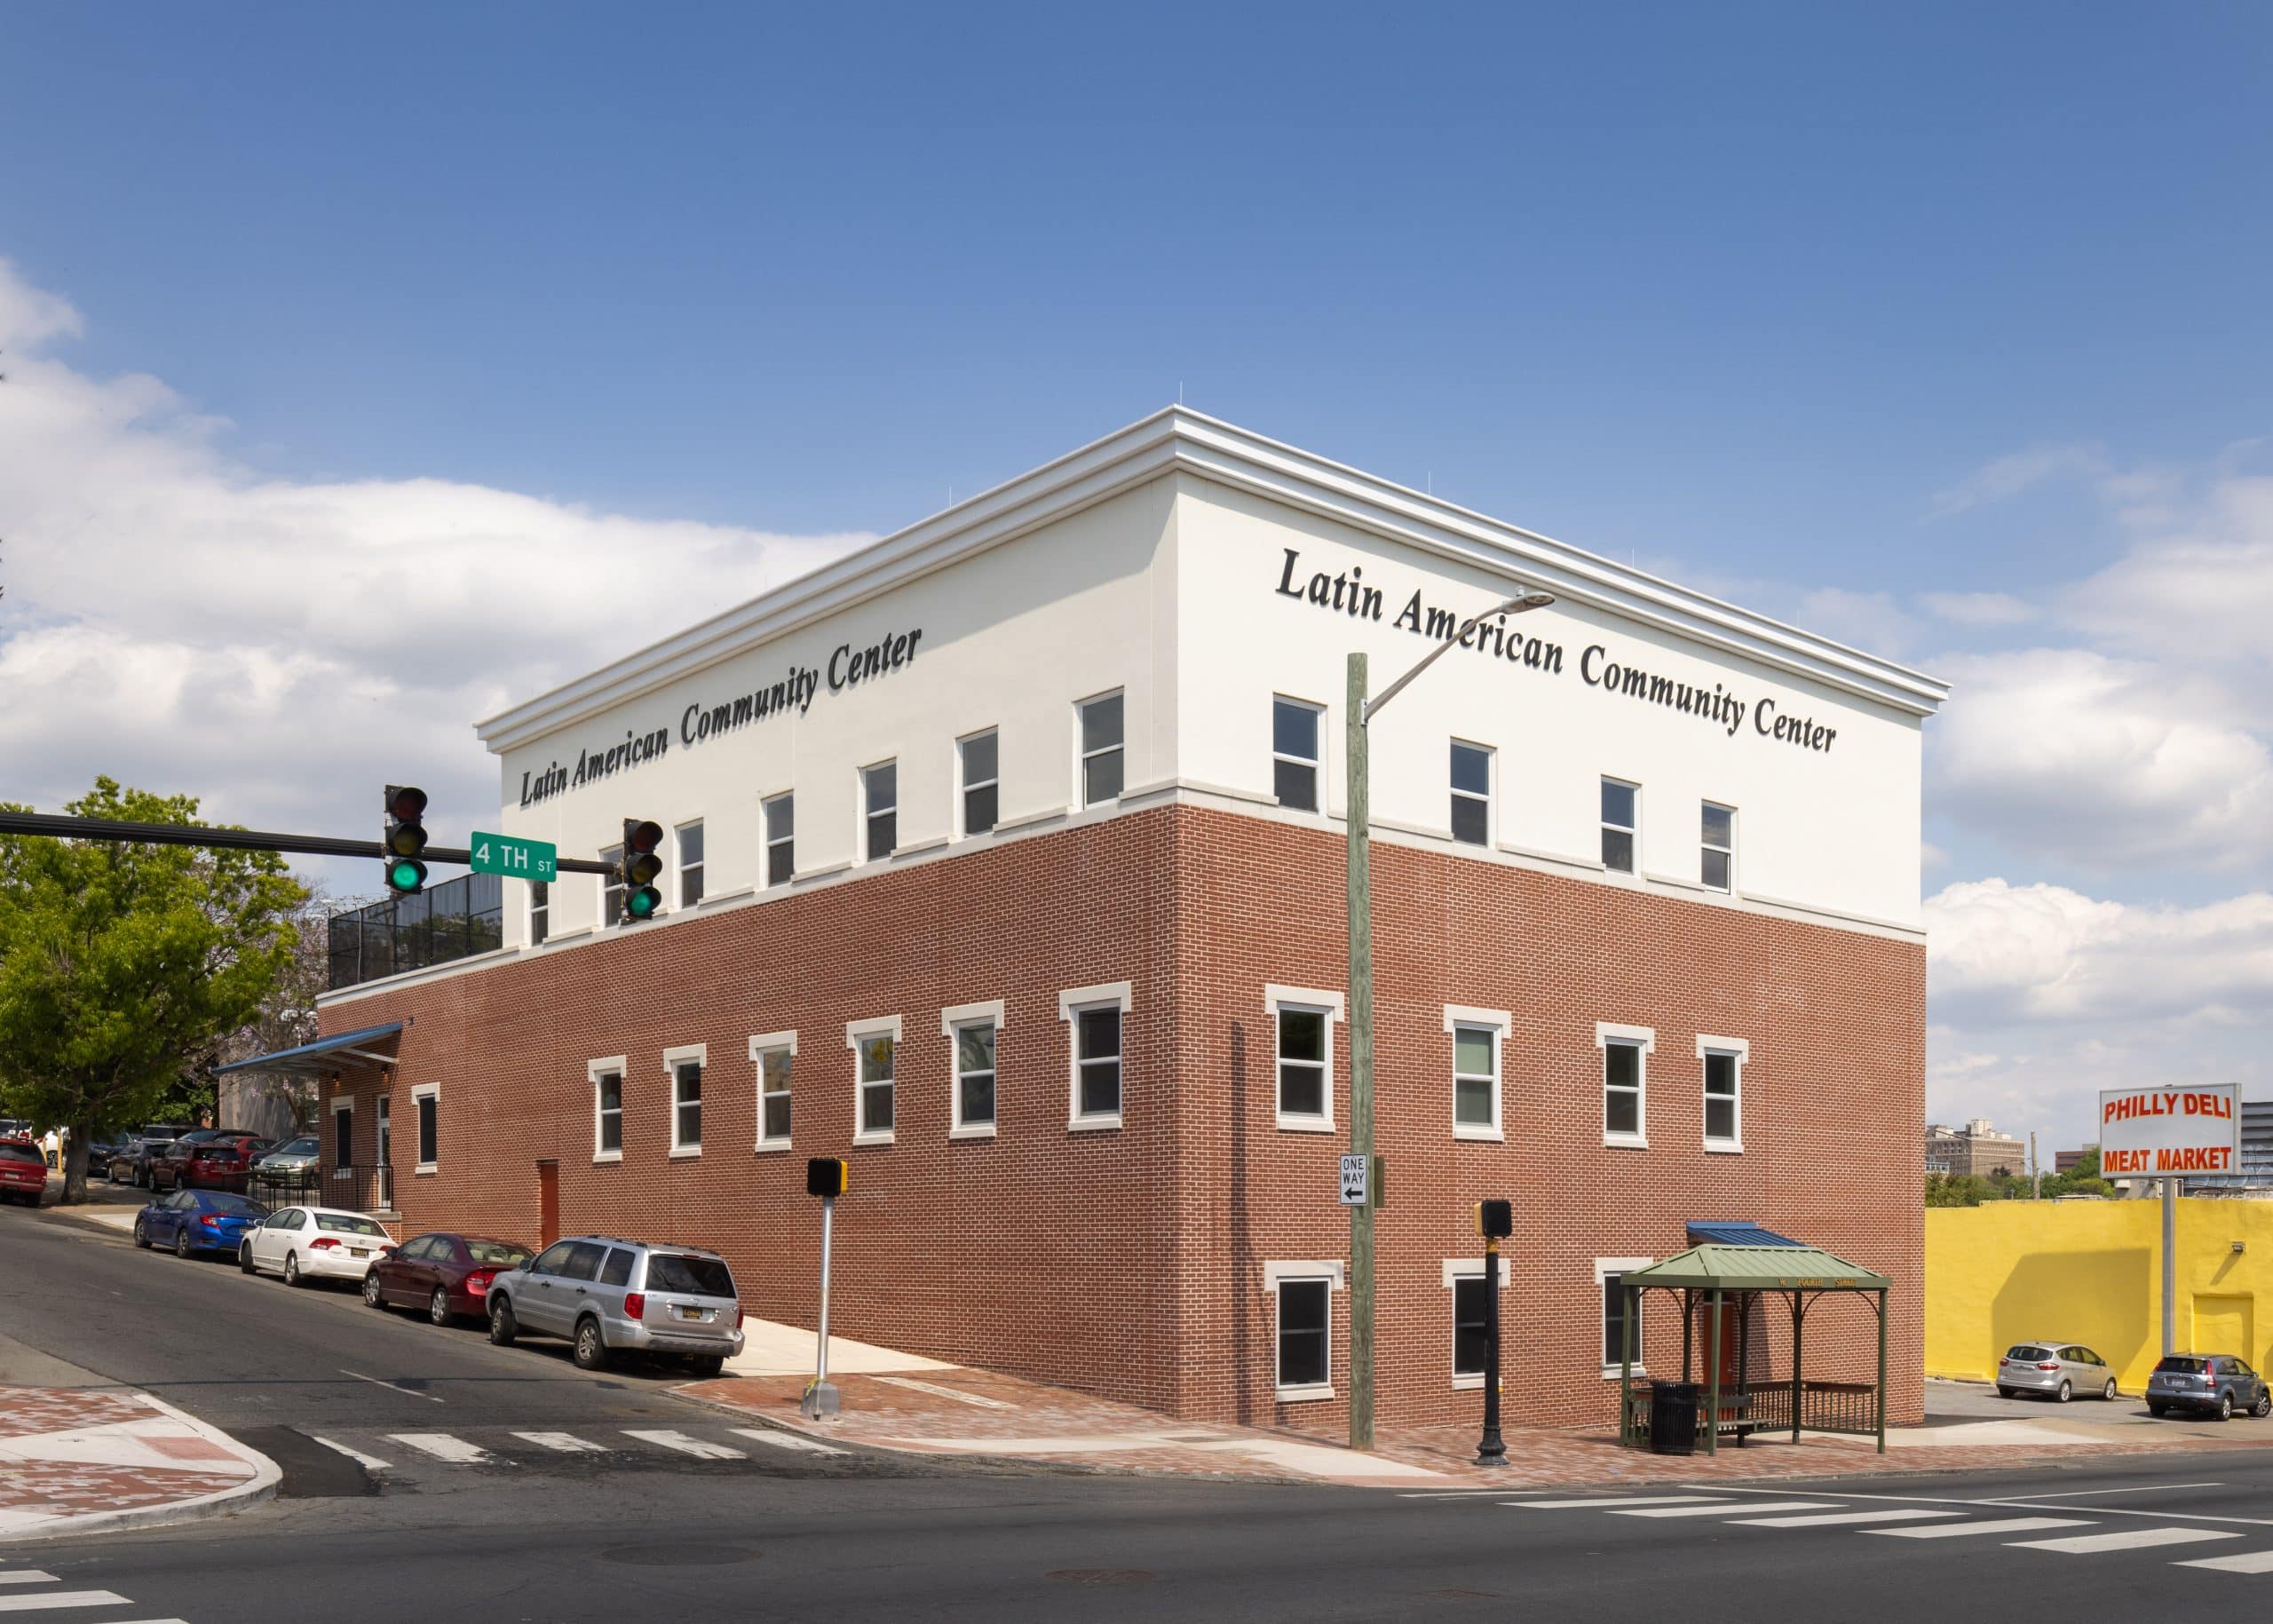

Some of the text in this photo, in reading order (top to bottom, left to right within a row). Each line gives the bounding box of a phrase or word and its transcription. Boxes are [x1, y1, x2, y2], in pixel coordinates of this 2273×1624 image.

[1275, 548, 1837, 753] Latin American Community Center
[520, 628, 923, 806] Latin American Community Center
[475, 843, 552, 872] 4 TH ST
[2104, 1093, 2232, 1124] PHILLY DELI
[1343, 1158, 1365, 1170] ONE
[2103, 1146, 2231, 1173] MEAT MARKET
[1343, 1172, 1365, 1184] WAY
